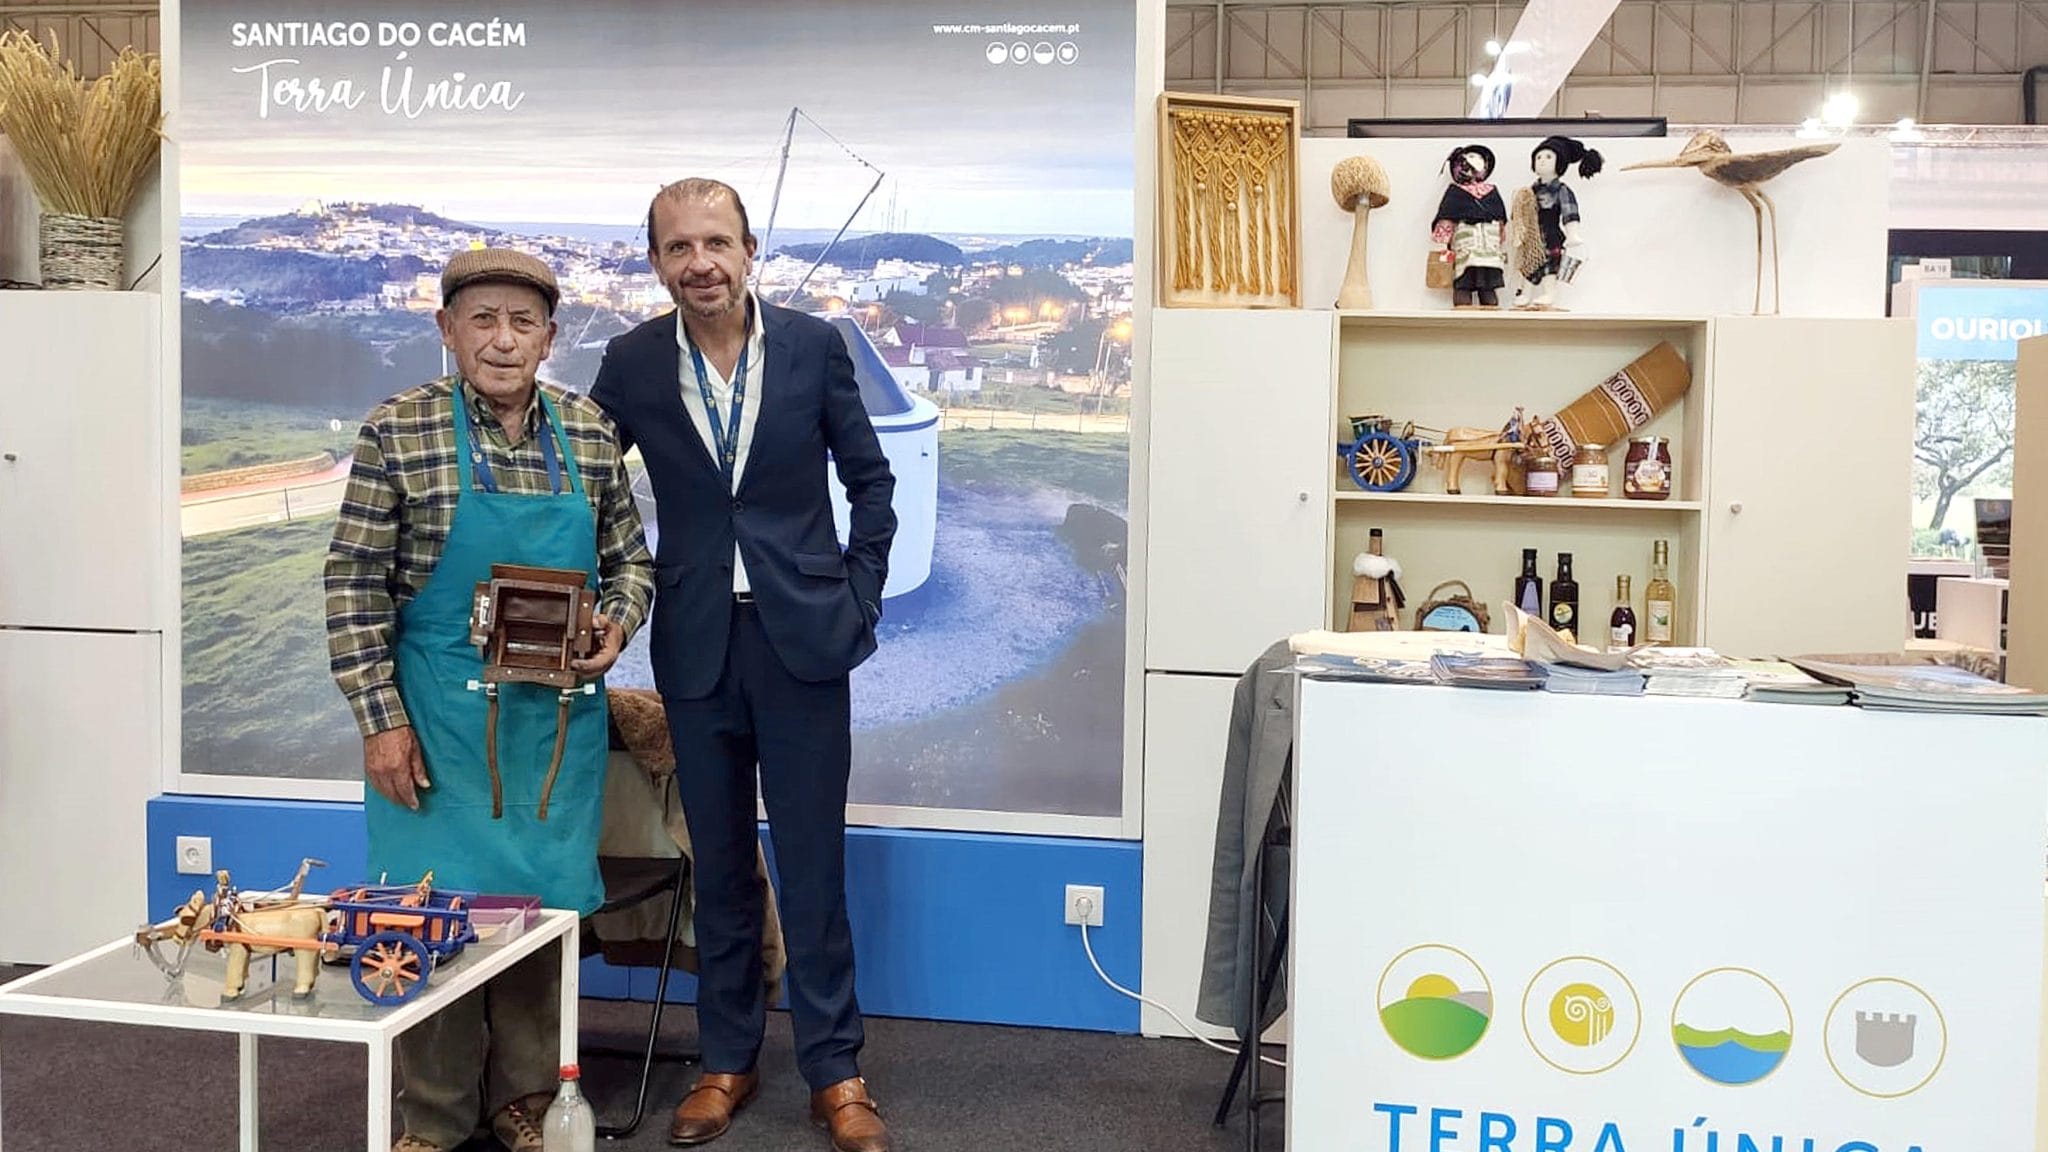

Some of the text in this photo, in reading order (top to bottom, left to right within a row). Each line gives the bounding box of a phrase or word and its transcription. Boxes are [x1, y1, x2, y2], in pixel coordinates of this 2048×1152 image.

[232, 17, 526, 47] SANTIAGO DO CACÉM
[933, 23, 1080, 35] www.cm-santiagocacem.pt
[232, 50, 526, 119] Terra Única
